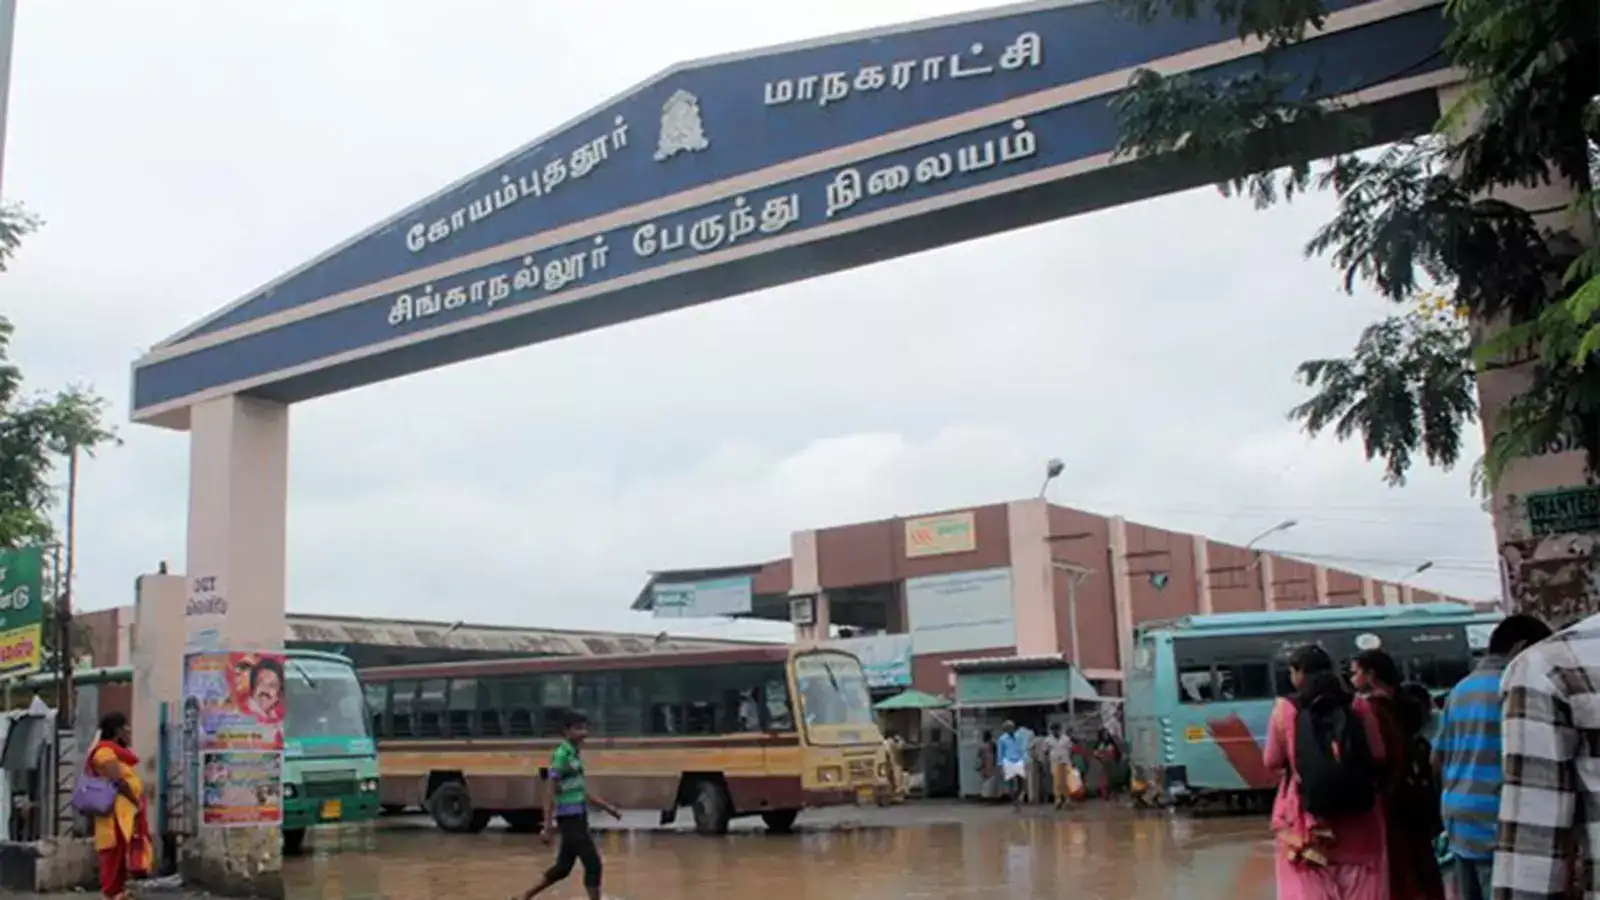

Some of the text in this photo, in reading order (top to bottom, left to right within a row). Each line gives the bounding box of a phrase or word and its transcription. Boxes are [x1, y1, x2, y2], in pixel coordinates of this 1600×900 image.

[763, 31, 1042, 107] மாநகராட்சி
[387, 118, 1037, 325] சிங்காநல்லூர் பேருந்து நிலையம்
